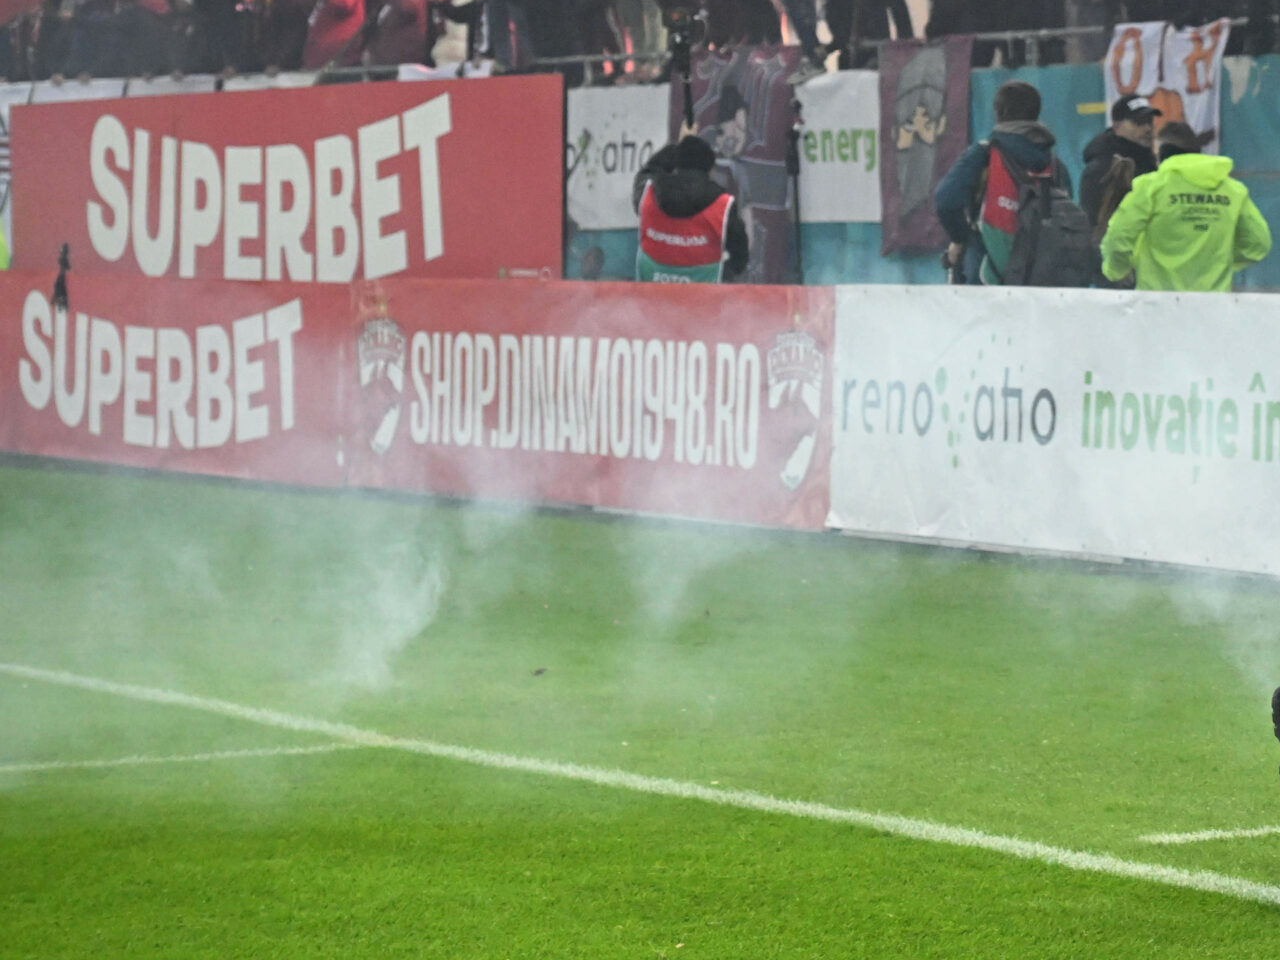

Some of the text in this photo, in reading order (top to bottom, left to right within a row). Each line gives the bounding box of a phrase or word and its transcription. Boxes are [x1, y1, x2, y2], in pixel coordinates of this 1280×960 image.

[87, 92, 452, 283] SUPERBET
[1169, 192, 1231, 206] STEWARD
[18, 290, 301, 450] SUPERBET
[410, 331, 760, 470] SHOP.DINAMO1948.RO
